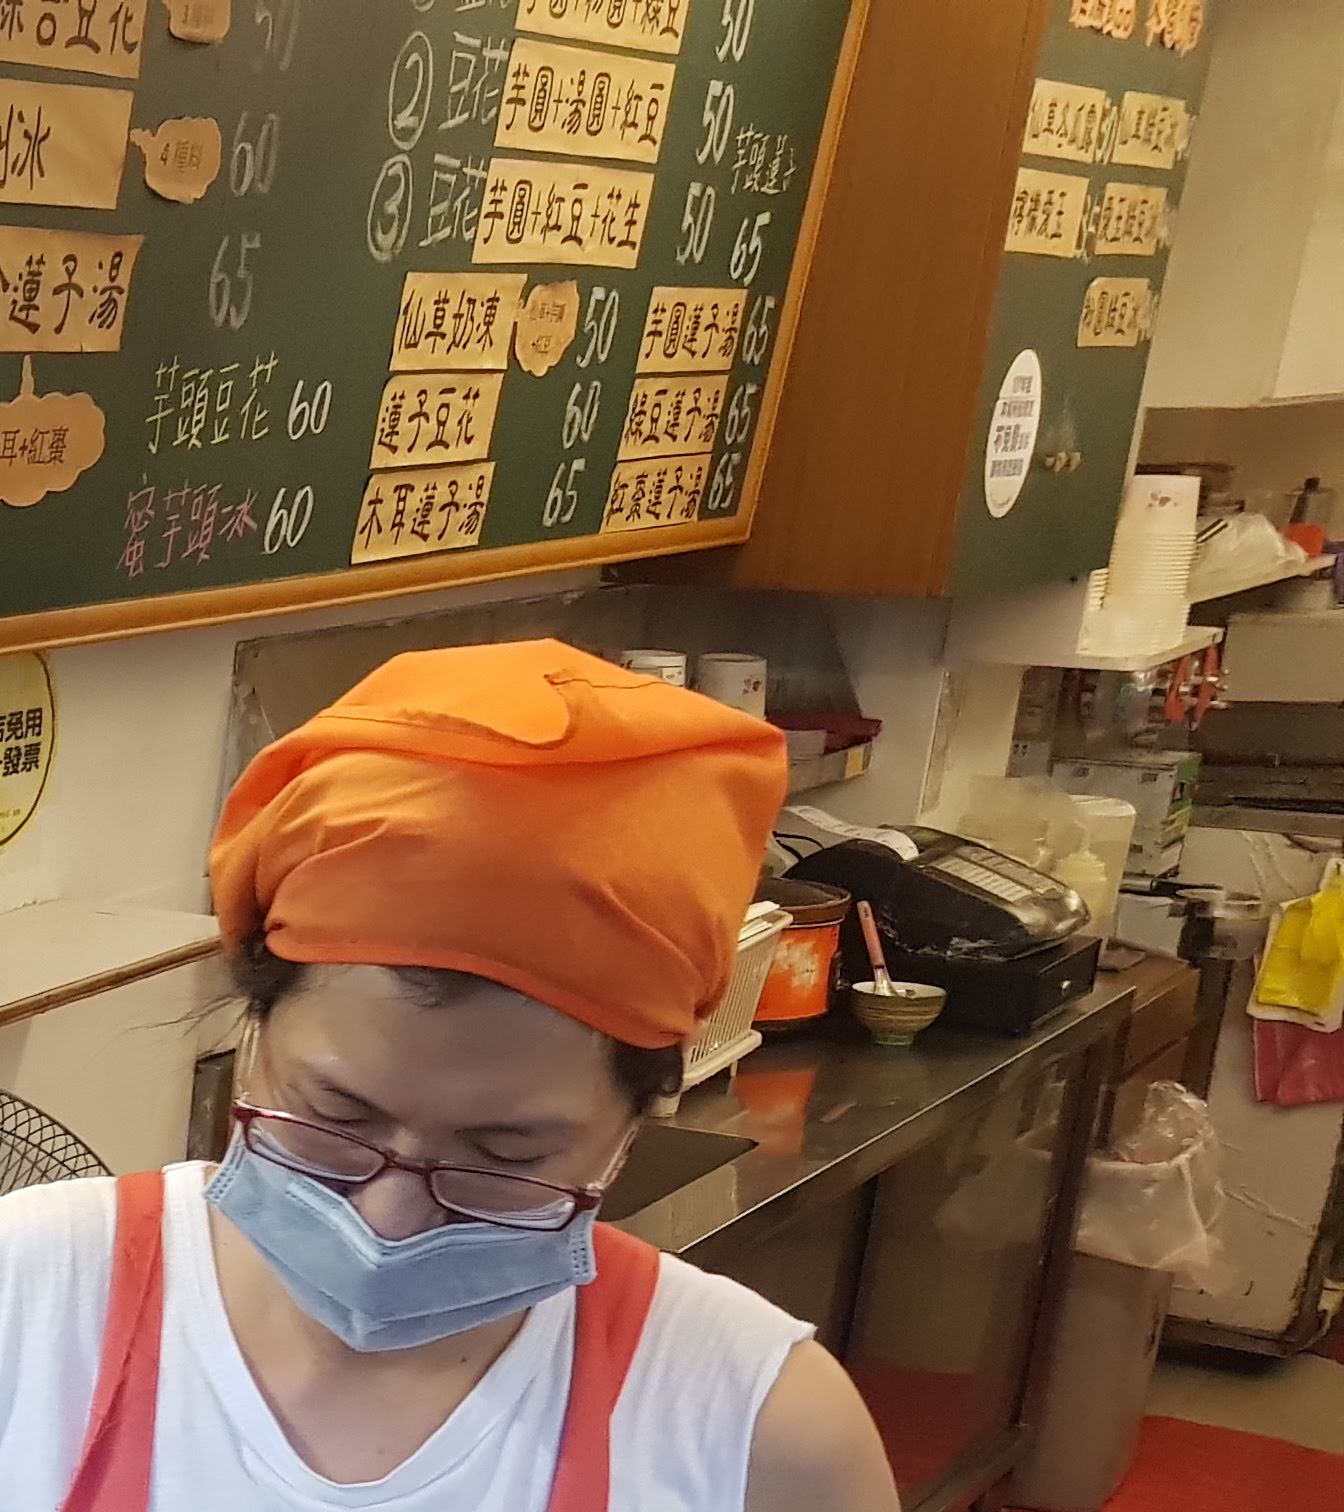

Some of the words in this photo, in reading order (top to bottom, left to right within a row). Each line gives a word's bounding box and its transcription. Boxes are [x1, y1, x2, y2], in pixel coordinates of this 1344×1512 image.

[230, 110, 280, 196] 60
[696, 79, 736, 165] 50
[676, 181, 716, 265] 50
[729, 211, 771, 286] 65
[210, 232, 262, 329] 65
[577, 286, 620, 368] 50
[742, 294, 776, 366] 65
[288, 380, 332, 440] 60
[378, 387, 481, 454] 蓮子豆花
[562, 380, 602, 449] 60
[724, 383, 760, 445] 65
[262, 485, 314, 555] 60
[360, 474, 486, 549] 木耳蓮子湯
[542, 458, 586, 527] 65
[708, 453, 742, 510] 65
